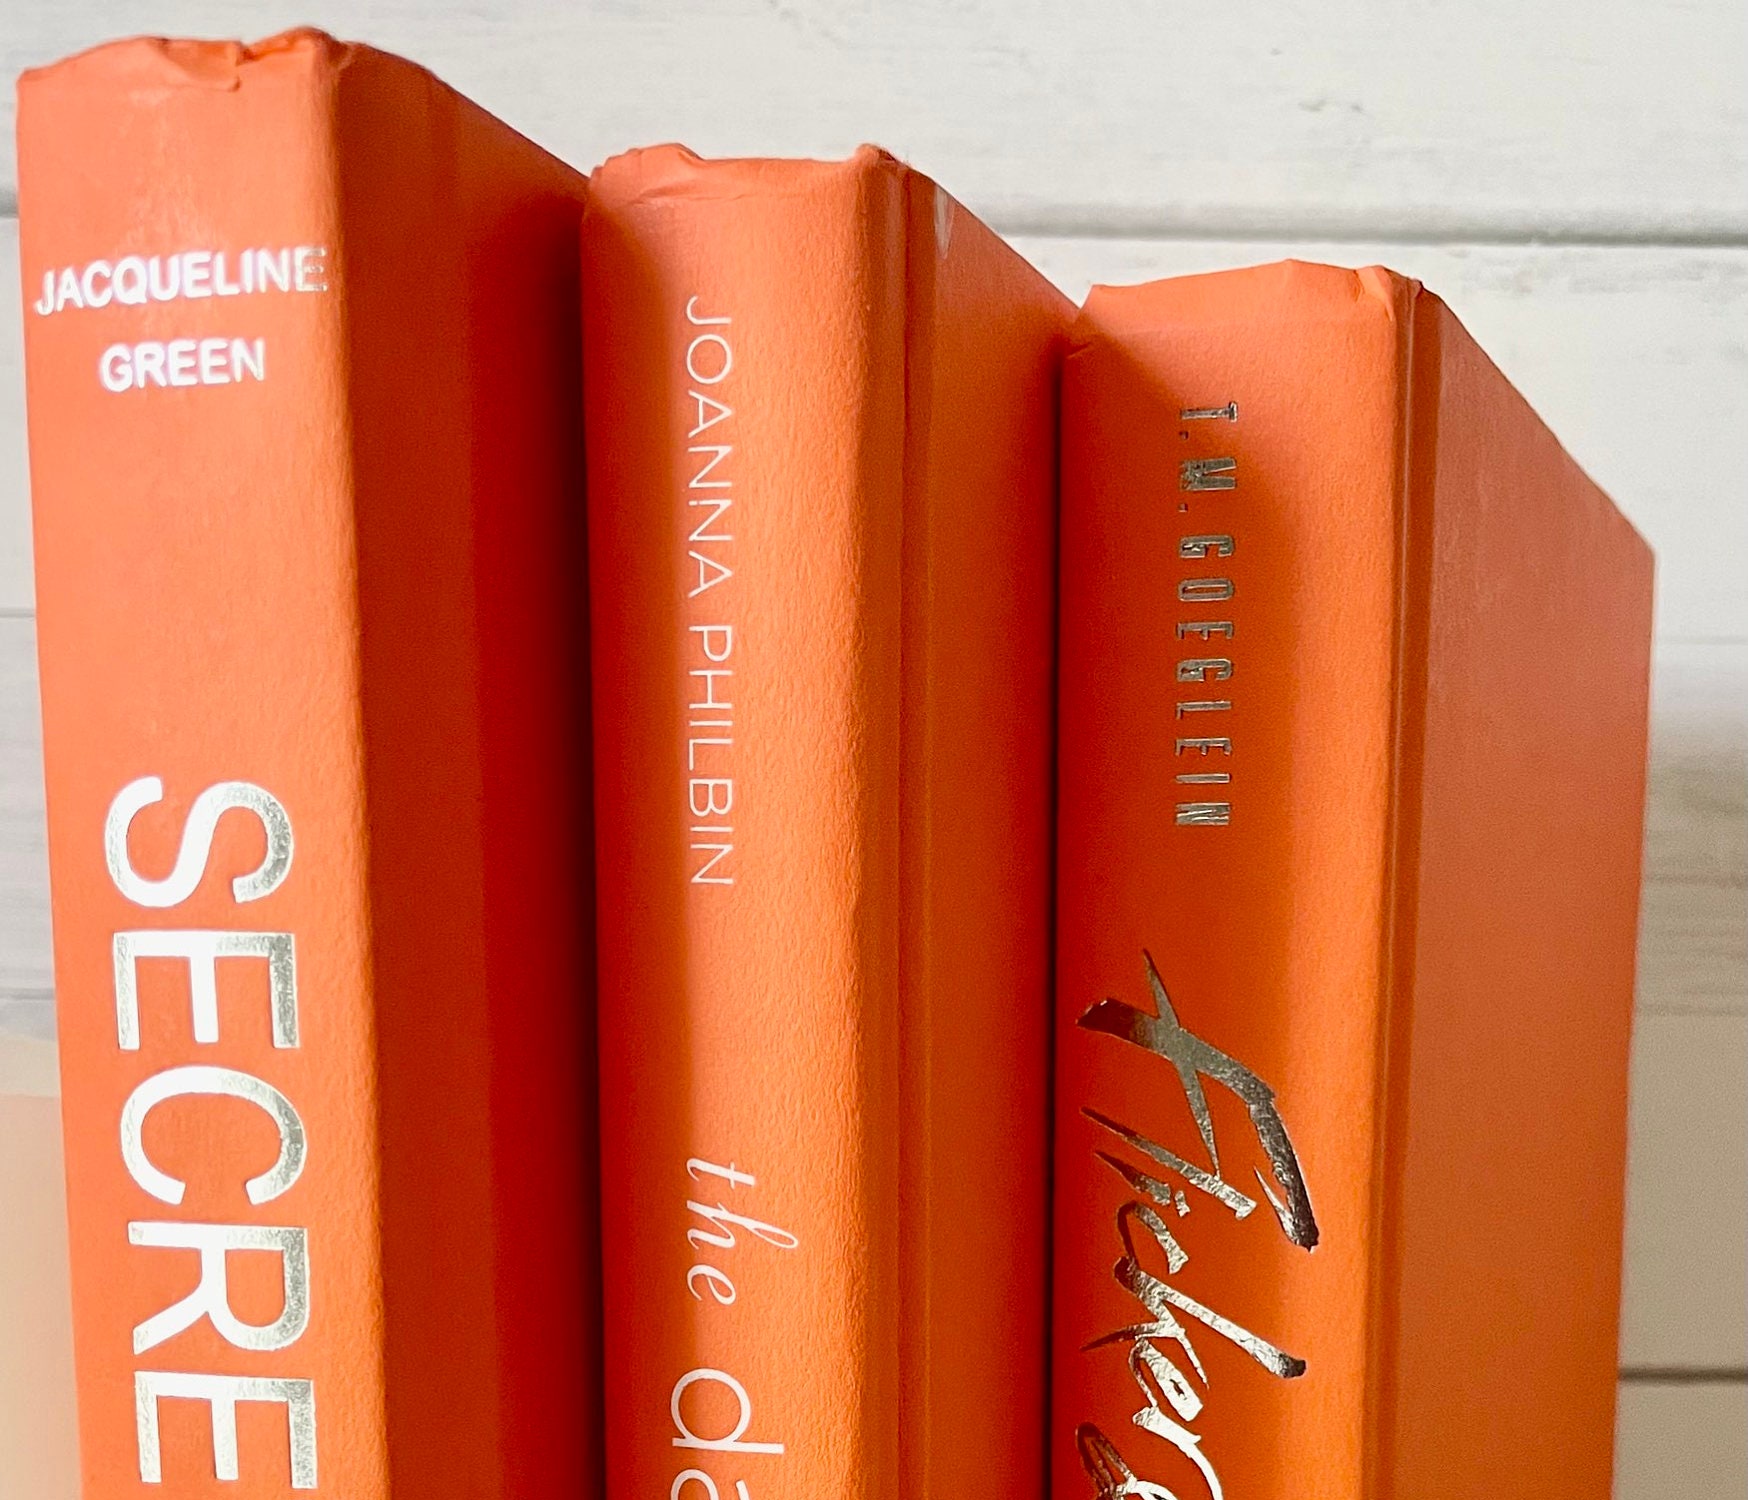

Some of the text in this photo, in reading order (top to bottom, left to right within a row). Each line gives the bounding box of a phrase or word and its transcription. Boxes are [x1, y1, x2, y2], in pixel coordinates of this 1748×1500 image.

[33, 246, 328, 316] JACQUELINE
[100, 337, 266, 392] GREEN
[686, 296, 734, 885] JOANNA PHILBIN
[1175, 534, 1235, 826] GOEGLEIN
[686, 1157, 799, 1305] the
